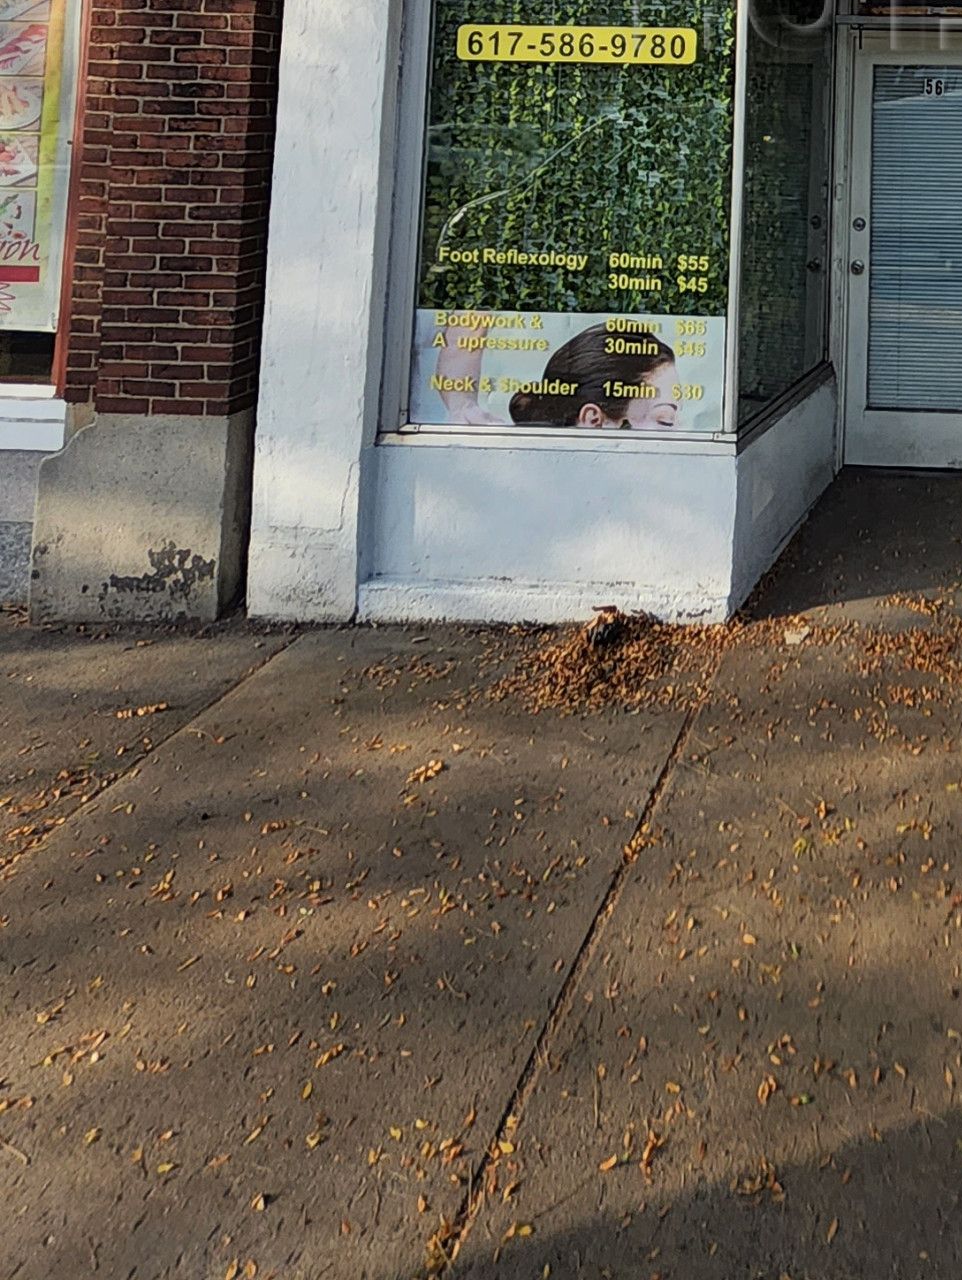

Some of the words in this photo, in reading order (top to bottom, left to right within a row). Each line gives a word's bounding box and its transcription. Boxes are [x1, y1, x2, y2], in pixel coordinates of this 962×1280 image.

[466, 30, 687, 60] 617-586-9780
[924, 77, 944, 96] 56
[438, 246, 479, 263] Foot
[482, 247, 589, 270] Reflexology
[608, 252, 663, 269] 60min
[677, 254, 710, 272] $55
[607, 273, 662, 291] 30min
[676, 275, 708, 293] $45
[434, 311, 526, 331] Bodywork
[529, 313, 543, 329] &
[605, 317, 662, 334] 60min
[604, 337, 659, 355] 30min
[429, 374, 475, 392] Neck
[479, 376, 492, 393] &
[500, 377, 579, 396] Shoulder
[602, 380, 658, 399] 15min
[671, 383, 704, 400] $30
